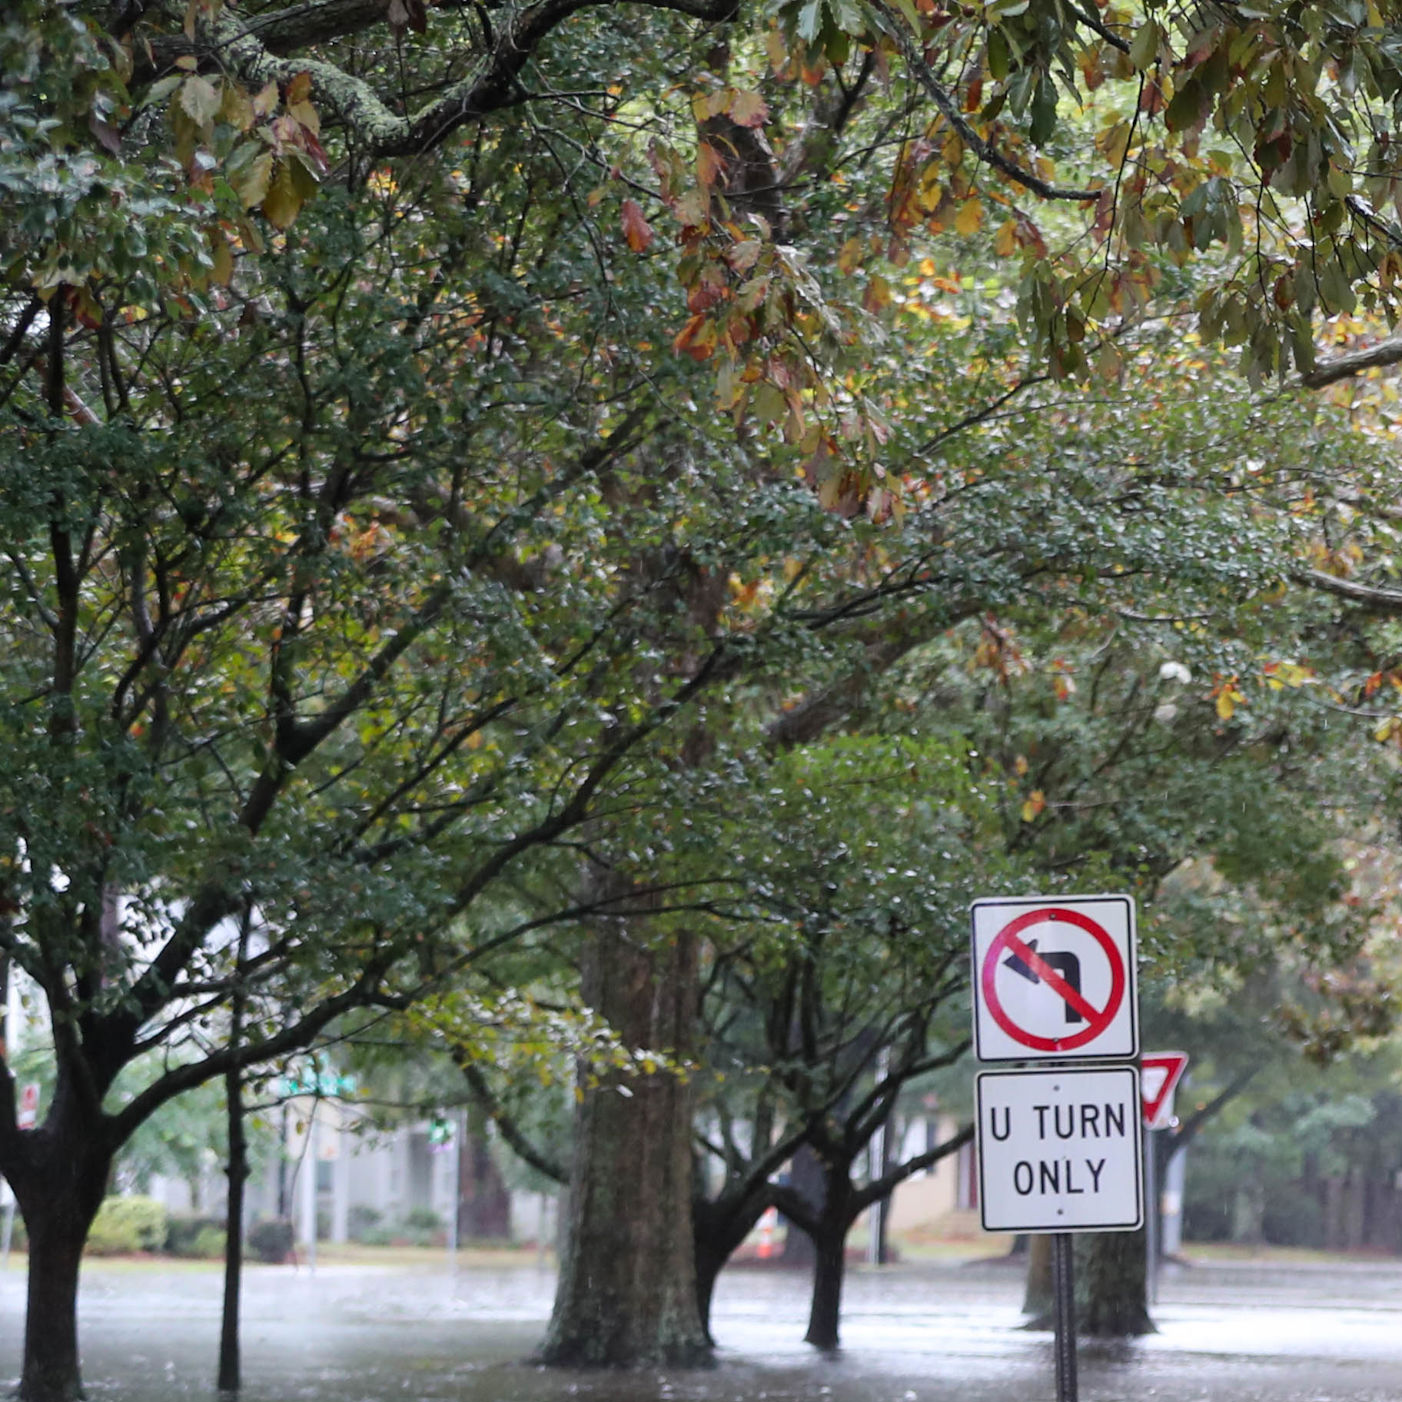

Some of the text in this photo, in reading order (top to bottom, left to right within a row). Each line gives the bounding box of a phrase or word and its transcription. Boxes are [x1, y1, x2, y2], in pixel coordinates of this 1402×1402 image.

[990, 1103, 1125, 1141] U TURN
[1013, 1159, 1106, 1195] ONLY
